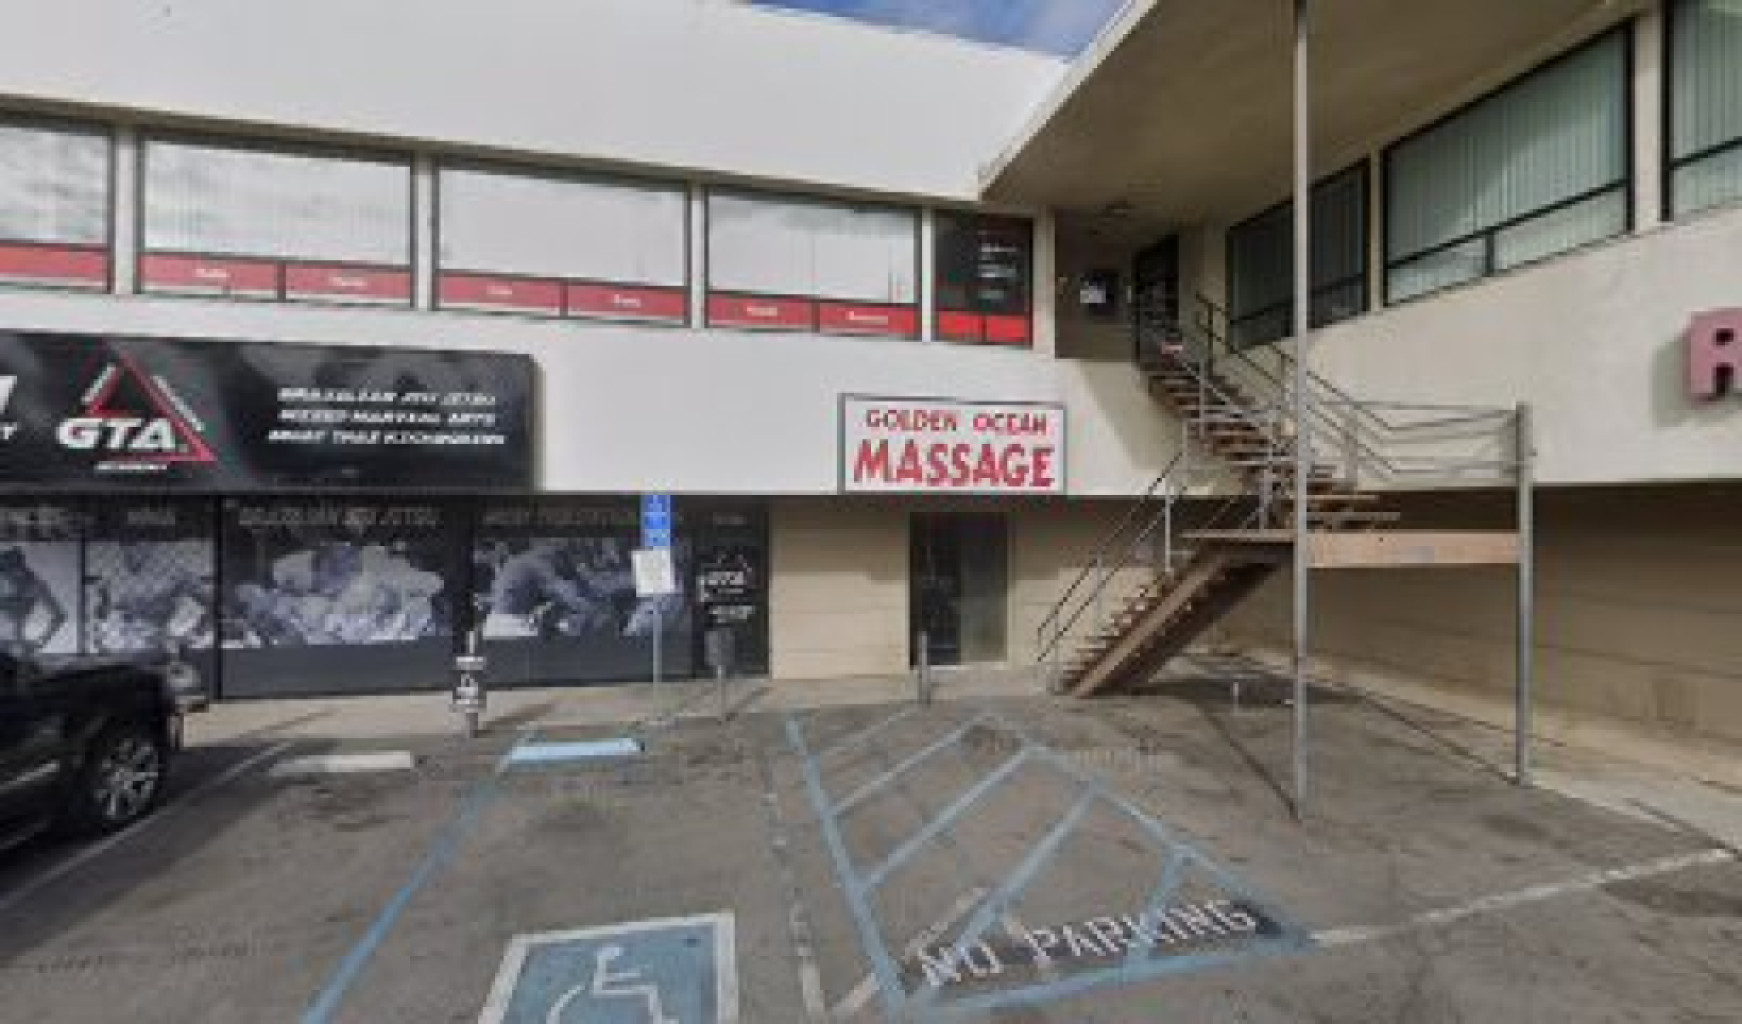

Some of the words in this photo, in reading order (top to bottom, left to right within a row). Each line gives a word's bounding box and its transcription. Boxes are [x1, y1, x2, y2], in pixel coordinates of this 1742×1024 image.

[56, 418, 176, 449] GTA
[865, 409, 957, 431] GOLDEN
[972, 412, 1047, 435] OCEAN
[853, 438, 1055, 487] MASSAGE
[916, 940, 1002, 986] NO
[1022, 899, 1256, 966] PARKING
